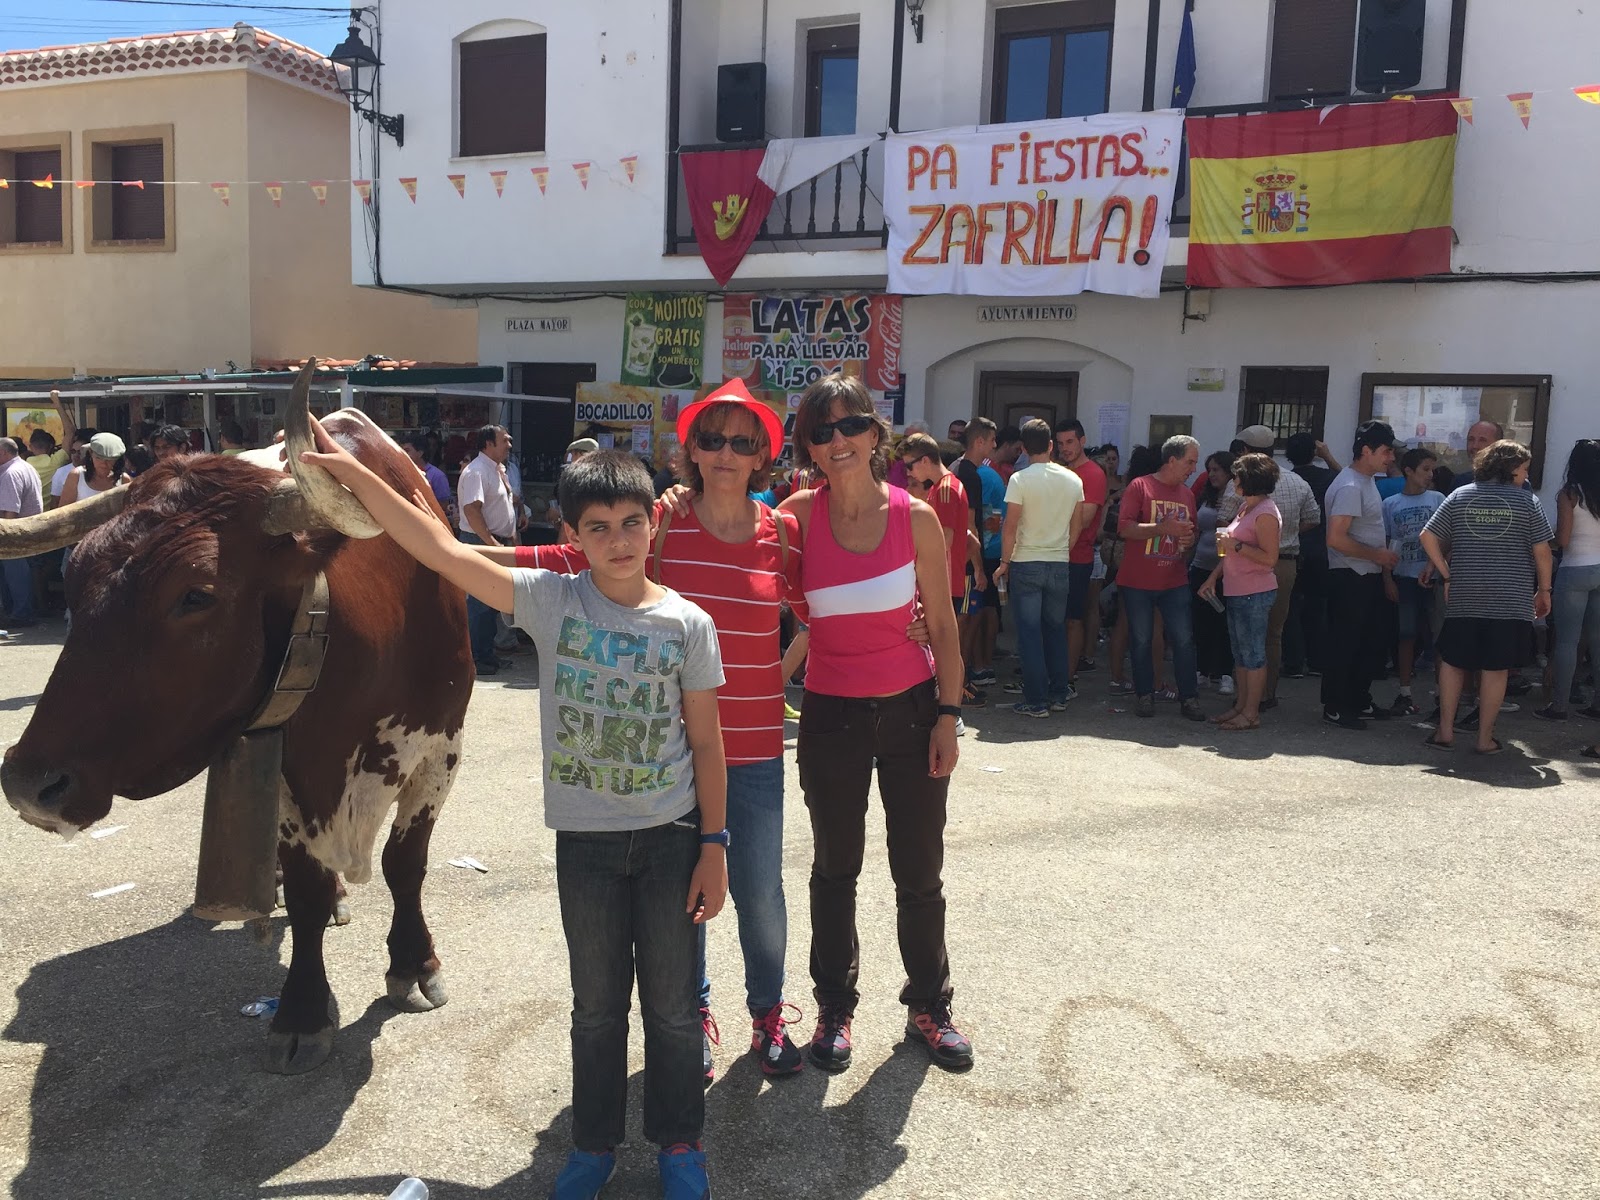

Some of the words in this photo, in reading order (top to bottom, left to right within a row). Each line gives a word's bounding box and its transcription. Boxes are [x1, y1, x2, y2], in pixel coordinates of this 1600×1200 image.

[907, 143, 958, 191] PA
[629, 299, 646, 309] CON
[647, 297, 654, 311] 2
[654, 296, 704, 322] MOJITOS
[751, 297, 871, 335] LATAS
[981, 306, 1074, 320] AYUNTAMIENTO
[507, 319, 535, 331] PLAZA
[540, 319, 569, 331] MAYOR
[655, 327, 701, 347] GRATIS
[657, 355, 700, 366] SOMBRERO
[671, 346, 681, 355] UN
[751, 342, 799, 360] PARA
[801, 342, 870, 360] LLEVAR
[774, 365, 823, 390] 1,50
[576, 402, 653, 421] BOCADILLOS
[1475, 515, 1502, 524] STORY
[556, 615, 685, 677] EXPLO
[556, 704, 672, 765] SURF
[549, 751, 677, 796] NATURE
